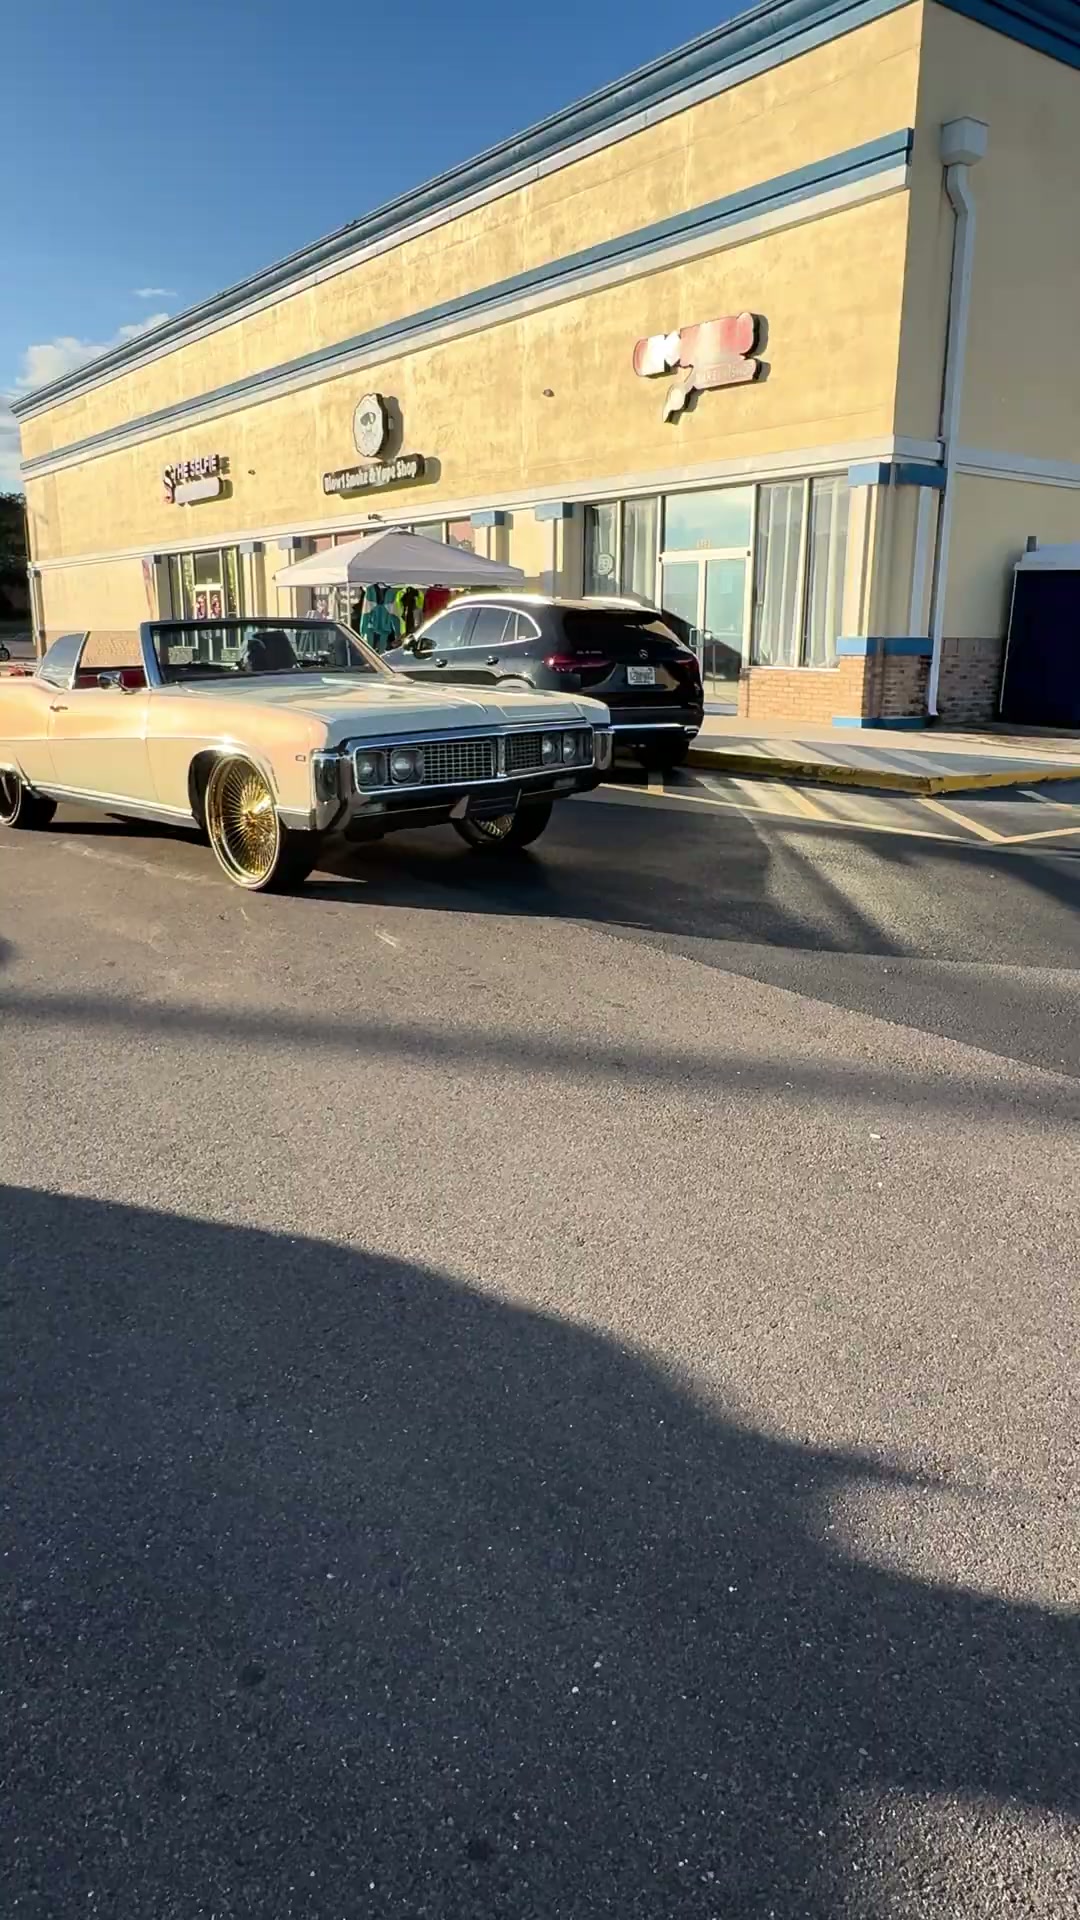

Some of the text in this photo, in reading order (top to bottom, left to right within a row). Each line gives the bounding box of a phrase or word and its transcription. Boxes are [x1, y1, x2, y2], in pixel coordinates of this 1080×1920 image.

[189, 454, 220, 478] SELFIE
[345, 468, 368, 489] Smoke
[375, 463, 396, 484] Vape
[396, 459, 417, 479] Shop
